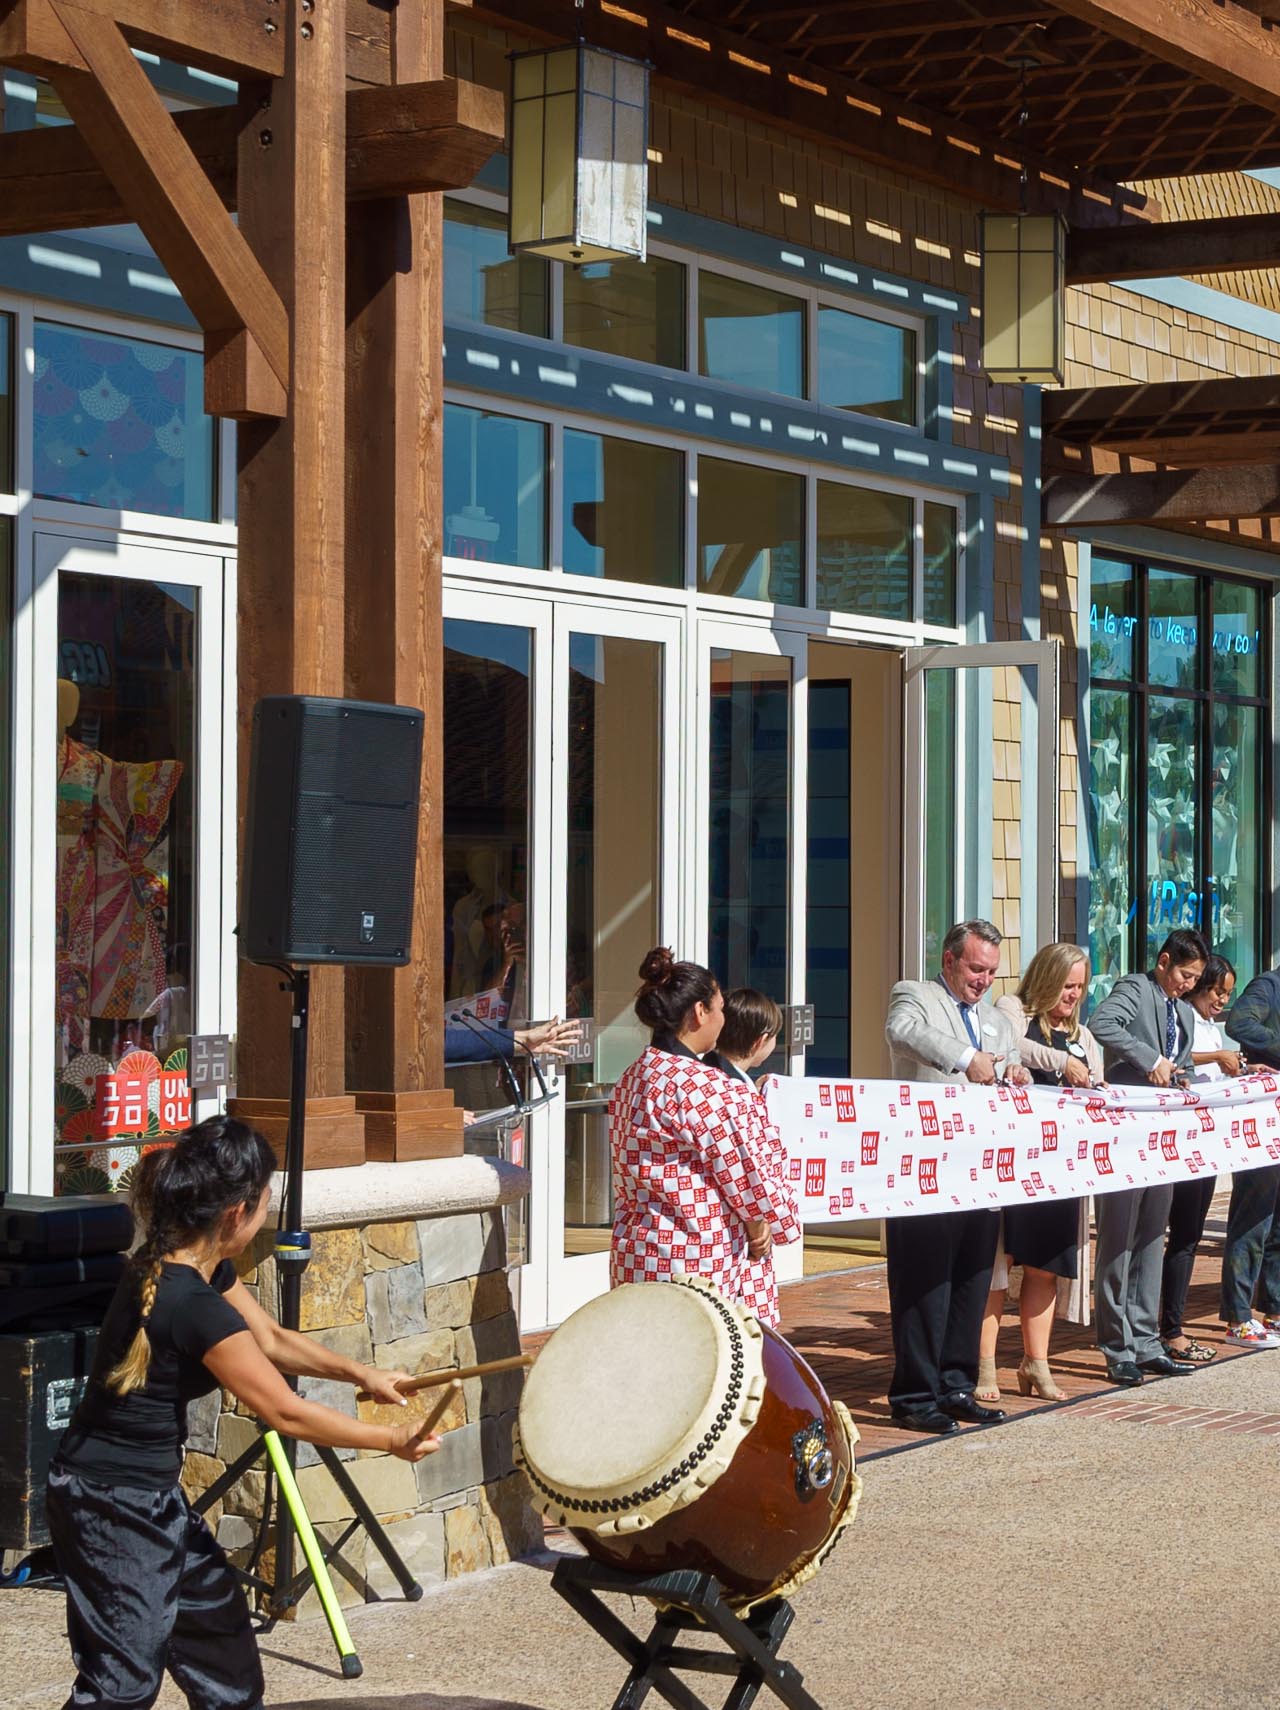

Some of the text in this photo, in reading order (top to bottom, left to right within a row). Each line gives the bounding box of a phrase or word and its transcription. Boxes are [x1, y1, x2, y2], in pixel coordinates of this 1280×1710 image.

[1089, 604, 1098, 631] A
[1104, 606, 1137, 641] layer
[569, 1042, 591, 1061] QLO
[164, 1078, 189, 1099] UN
[836, 1089, 851, 1103] UNI
[839, 1105, 854, 1120] QLO
[920, 1105, 935, 1117] UNI
[1014, 1099, 1030, 1113] QLO
[922, 1120, 938, 1134] QLO
[1043, 1124, 1056, 1136] UNI
[863, 1136, 877, 1147] UNI
[1043, 1137, 1057, 1150] QLO
[1162, 1133, 1175, 1145] UNI
[1245, 1134, 1259, 1147] QLO
[862, 1149, 876, 1163] QLO
[999, 1152, 1012, 1164] UNI
[1094, 1146, 1107, 1159] UNI
[1164, 1146, 1178, 1160] QLO
[808, 1163, 823, 1176] UNI
[920, 1163, 935, 1175] UNI
[998, 1165, 1013, 1180] QLO
[1096, 1160, 1111, 1174] QLO
[807, 1179, 823, 1194] QLO
[920, 1177, 936, 1192] QLO
